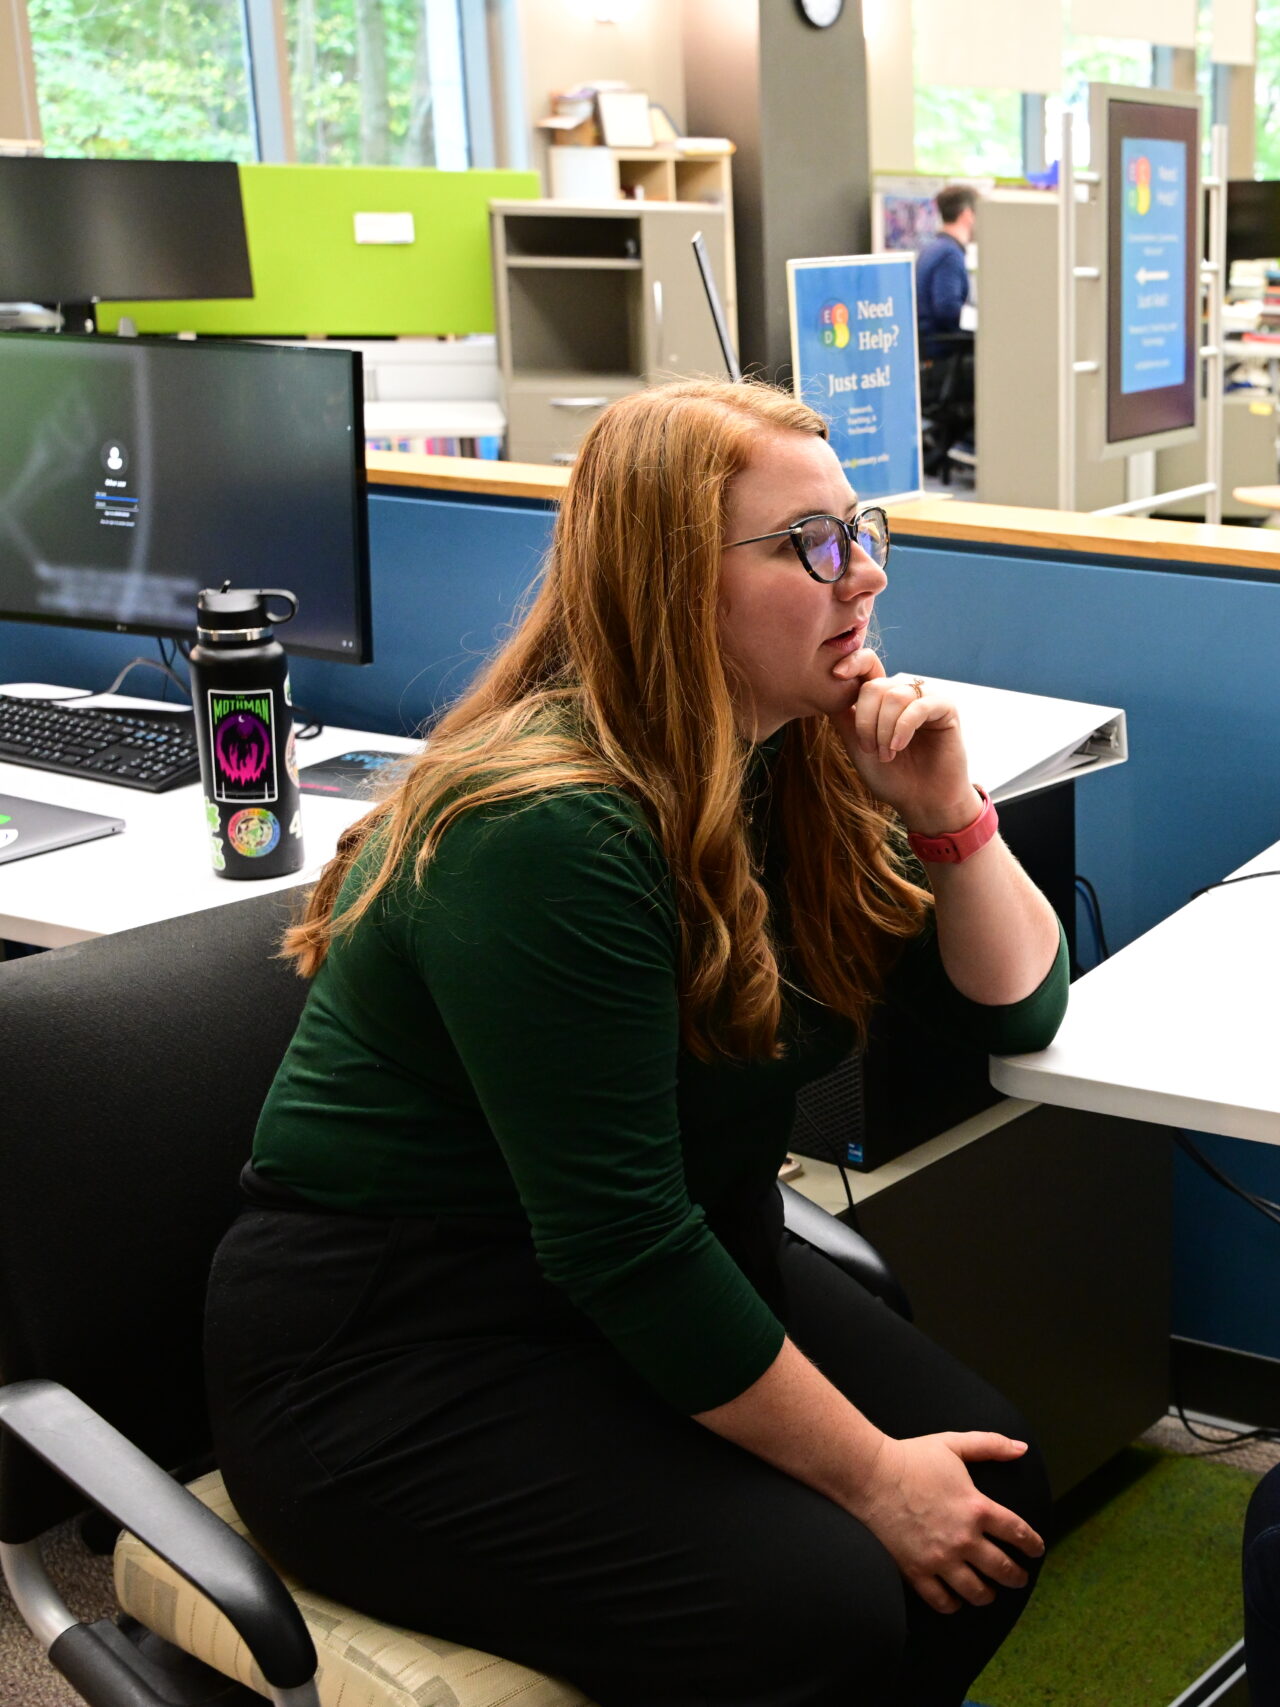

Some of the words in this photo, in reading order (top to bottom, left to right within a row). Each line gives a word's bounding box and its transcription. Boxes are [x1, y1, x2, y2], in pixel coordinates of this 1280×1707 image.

[857, 296, 894, 320] Need
[858, 324, 900, 353] Help?
[827, 372, 858, 397] Just
[861, 364, 891, 389] ask!
[213, 698, 270, 725] MOTHMAN
